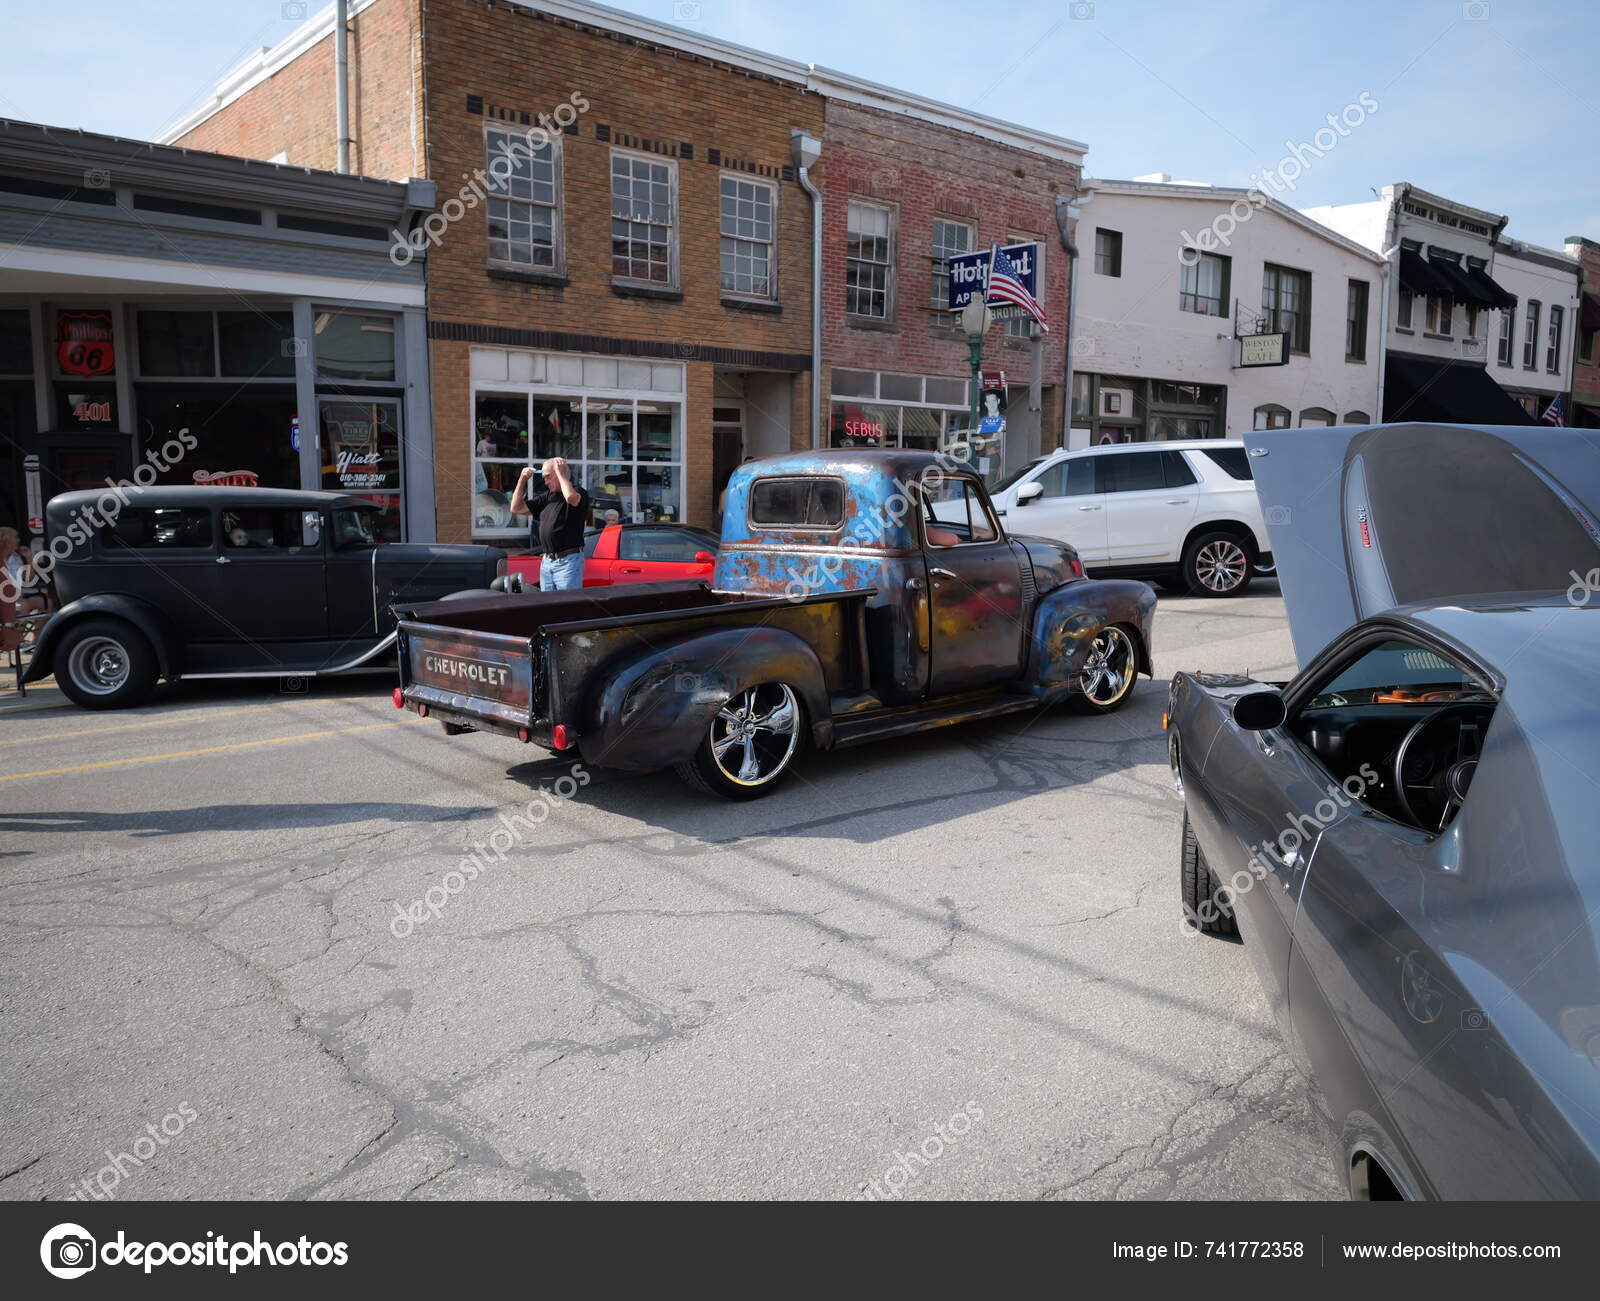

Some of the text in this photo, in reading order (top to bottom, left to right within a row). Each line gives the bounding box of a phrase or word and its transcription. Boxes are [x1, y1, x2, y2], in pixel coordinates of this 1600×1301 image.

[69, 343, 105, 370] 66
[72, 402, 111, 421] 401
[845, 421, 884, 438] SEBUS
[336, 451, 384, 473] Hiatt
[425, 656, 508, 686] CHEVROLET
